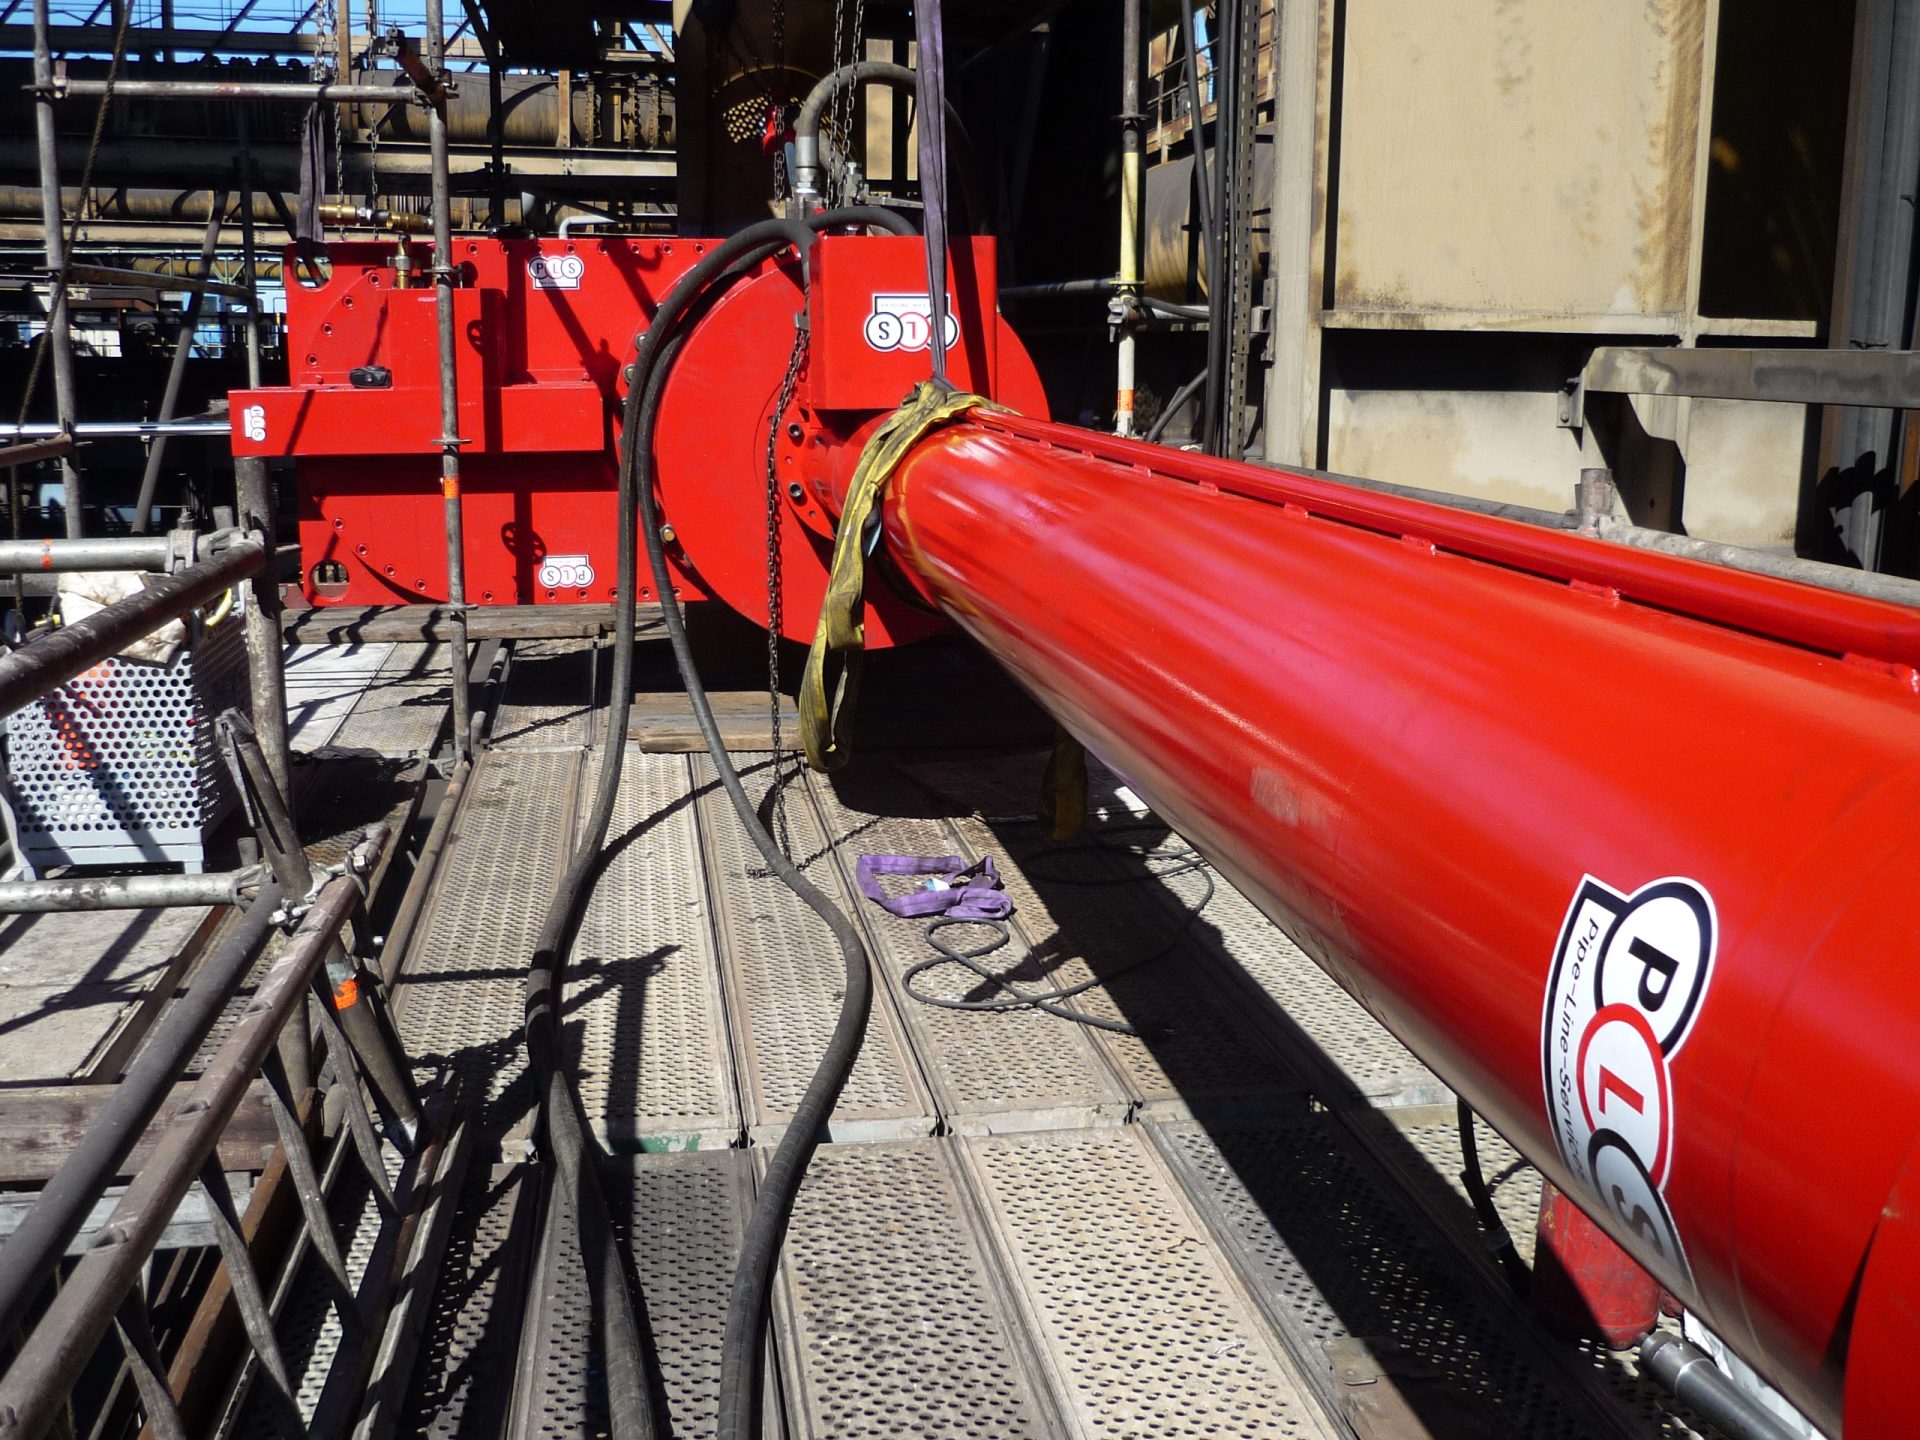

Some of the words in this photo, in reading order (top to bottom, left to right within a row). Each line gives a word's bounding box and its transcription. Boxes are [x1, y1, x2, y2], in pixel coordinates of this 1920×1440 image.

[536, 262, 576, 274] PLS
[547, 570, 585, 581] PLS
[1559, 917, 1600, 1186] Pipe-Line-Services
[1598, 936, 1680, 1257] PLS
